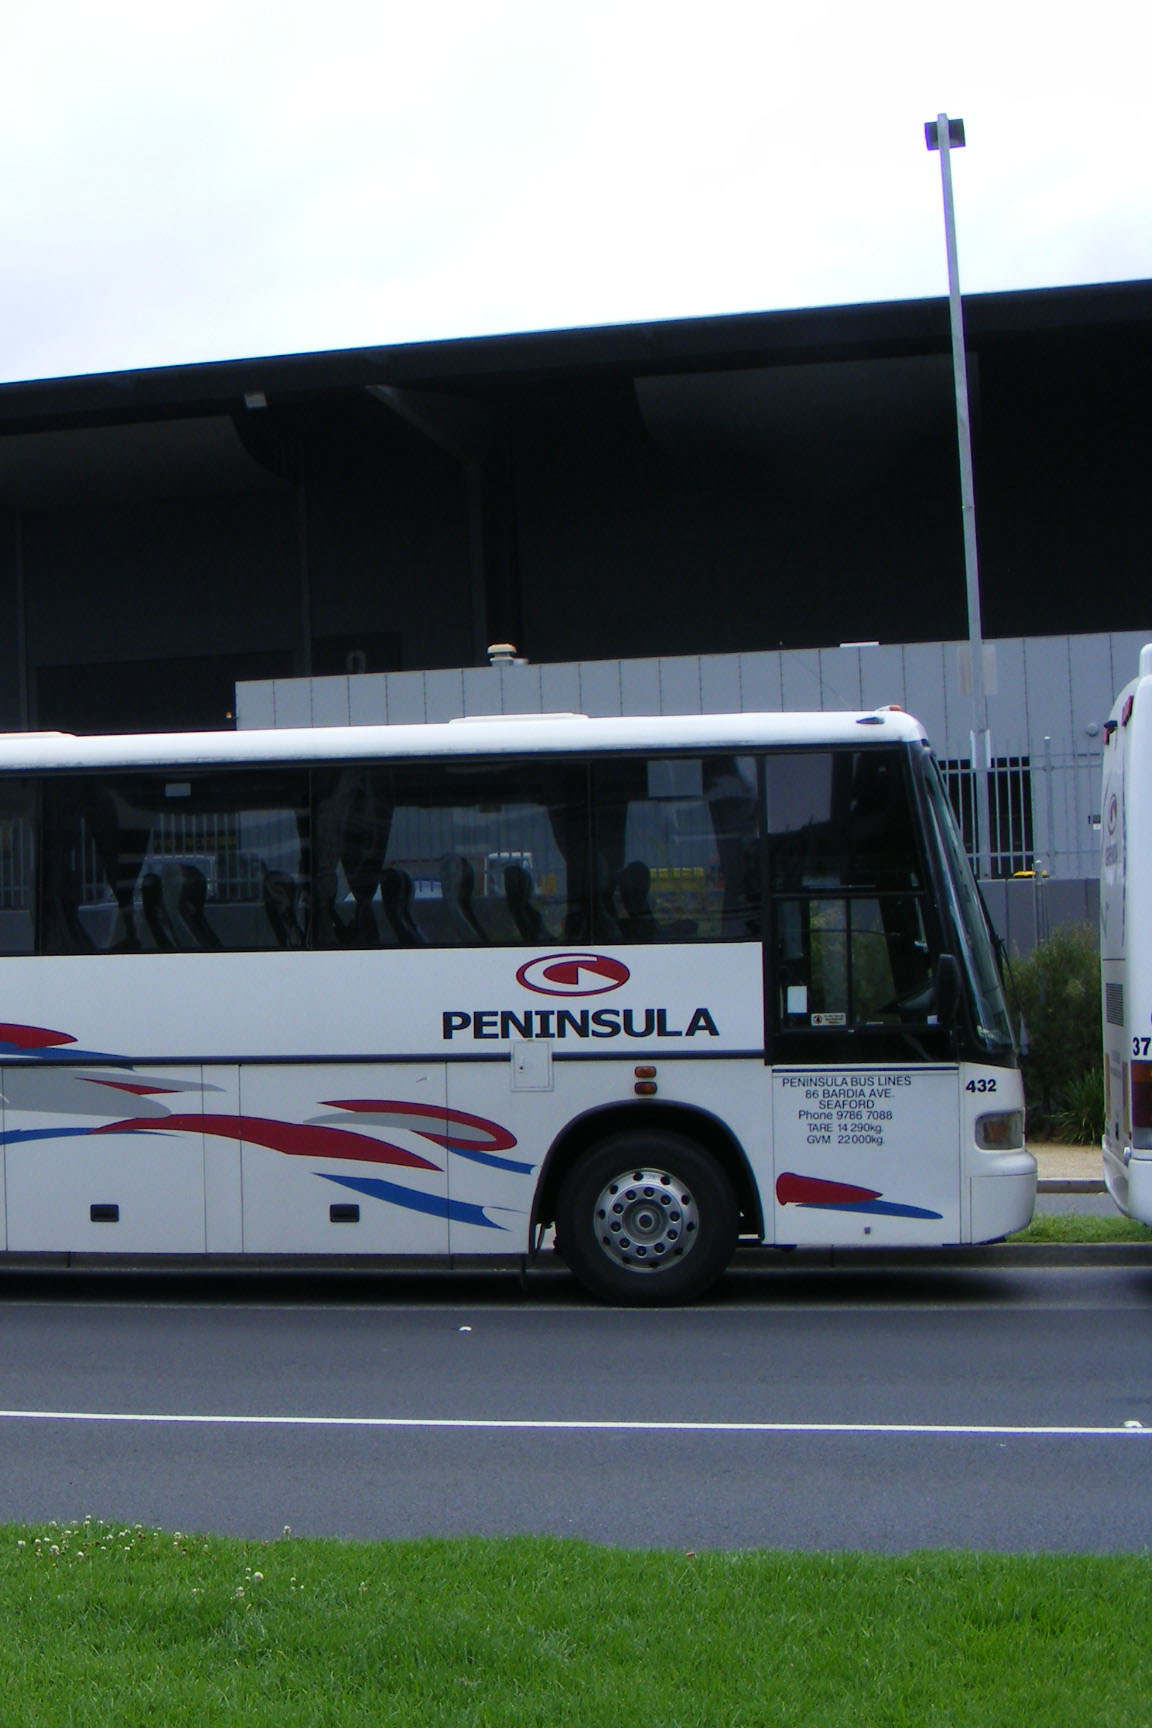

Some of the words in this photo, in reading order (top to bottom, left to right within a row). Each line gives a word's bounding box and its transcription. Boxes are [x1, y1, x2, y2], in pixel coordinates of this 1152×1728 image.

[443, 1008, 720, 1039] PENINSULA
[782, 1077, 848, 1087] PENINSULA
[851, 1077, 875, 1087] BUS
[878, 1076, 912, 1086] LINES
[965, 1079, 997, 1092] 432
[805, 1089, 819, 1099] 86
[822, 1089, 866, 1099] BARDIA
[818, 1100, 874, 1109] SEAFORD
[798, 1111, 833, 1120] Phone
[836, 1111, 863, 1120] 9786
[866, 1110, 893, 1120] 7088
[807, 1123, 833, 1132] TARE
[838, 1123, 848, 1132] 14
[807, 1135, 831, 1144] GVM
